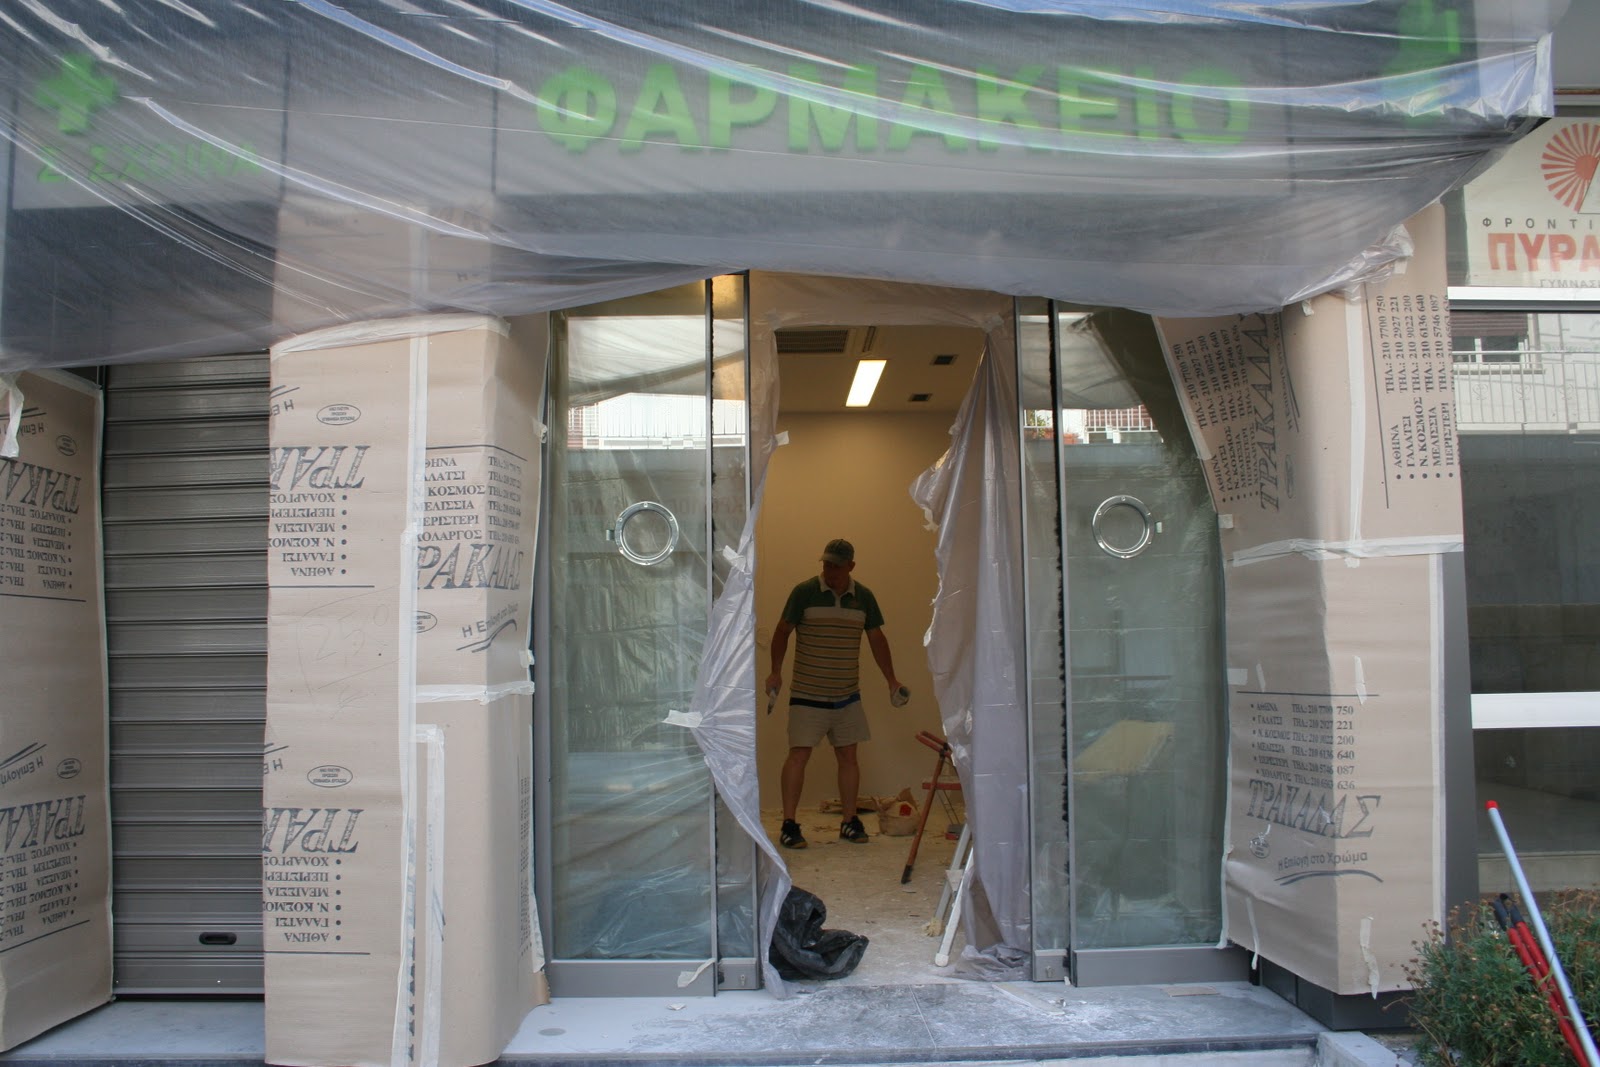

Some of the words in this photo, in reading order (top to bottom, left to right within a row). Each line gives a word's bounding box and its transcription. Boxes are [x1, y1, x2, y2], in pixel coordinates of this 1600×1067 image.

[537, 63, 1251, 154] ΦΑΡΜΑΚΕΙΟ
[1482, 217, 1593, 229] ΦΡΟΝΤΙ
[1488, 233, 1600, 272] ΠΥΡΑ
[1377, 295, 1385, 313] 750
[1390, 296, 1398, 312] 221
[1403, 295, 1411, 312] 200
[1417, 295, 1425, 312] 640
[1430, 295, 1438, 312] 087
[1378, 316, 1389, 340] 7700
[1392, 315, 1403, 339] 2927
[1405, 315, 1416, 339] 9022
[1419, 314, 1429, 338] 6136
[1433, 314, 1442, 337] 5746
[1185, 340, 1197, 355] 221
[1209, 332, 1219, 347] 640
[1173, 344, 1184, 360] 750
[1383, 342, 1391, 360] 210
[1396, 342, 1404, 359] 210
[1409, 342, 1417, 359] 210
[1422, 341, 1431, 358] 210
[1436, 341, 1444, 358] 210
[1191, 359, 1204, 378] 2927
[1215, 350, 1226, 371] 6136
[1179, 362, 1192, 383] 7700
[1232, 371, 1240, 387] 210
[1199, 380, 1210, 396] 210
[1211, 377, 1221, 392] 210
[1222, 374, 1231, 390] 210
[1187, 383, 1198, 399] 210
[284, 400, 294, 410] Η
[1414, 397, 1427, 451] ΚΟΣΜΟΣ
[1403, 416, 1414, 467] ΓΑΛΑΤΣΙ
[1429, 407, 1441, 466] ΜΕΛΙΣΣΙΑ
[1441, 402, 1454, 466] ΠΕΡΙΣΤΕΡΙ
[1224, 426, 1238, 475] ΚΟΣΜΟΣ
[1391, 424, 1402, 467] ΑΘΗΝΑ
[1420, 455, 1428, 466] Ν.
[270, 493, 335, 503] ΧΟΛΑΡΓΟΣ
[428, 485, 486, 496] ΚΟΣΜΟΣ
[272, 508, 335, 517] ΠΕΡΙΣΤΕΡΙ
[275, 523, 335, 532] ΜΕΛΙΣΣΙΑ
[324, 538, 335, 547] Ν.
[282, 552, 334, 562] ΓΑΛΑΤΣΙ
[291, 567, 335, 576] ΑΘΗΝΑ
[416, 543, 524, 590] ΡΑΚΑΔΑΣ
[462, 626, 472, 638] Η
[1337, 706, 1353, 715] 750
[1337, 721, 1353, 730] 221
[1337, 736, 1354, 745] 200
[1337, 751, 1354, 760] 640
[273, 758, 283, 770] Η
[1337, 766, 1354, 775] 087
[1337, 781, 1354, 789] 636
[1247, 779, 1380, 839] ΤΡΑΚΑΔΑΣ
[1327, 851, 1368, 867] Χρώμα
[267, 887, 329, 897] ΜΕΛΙΣΣΙΑ
[317, 902, 329, 912] Ν.
[276, 917, 329, 927] ΓΑΛΑΤΣΙ
[284, 933, 329, 942] ΑΘΗΝΑ
